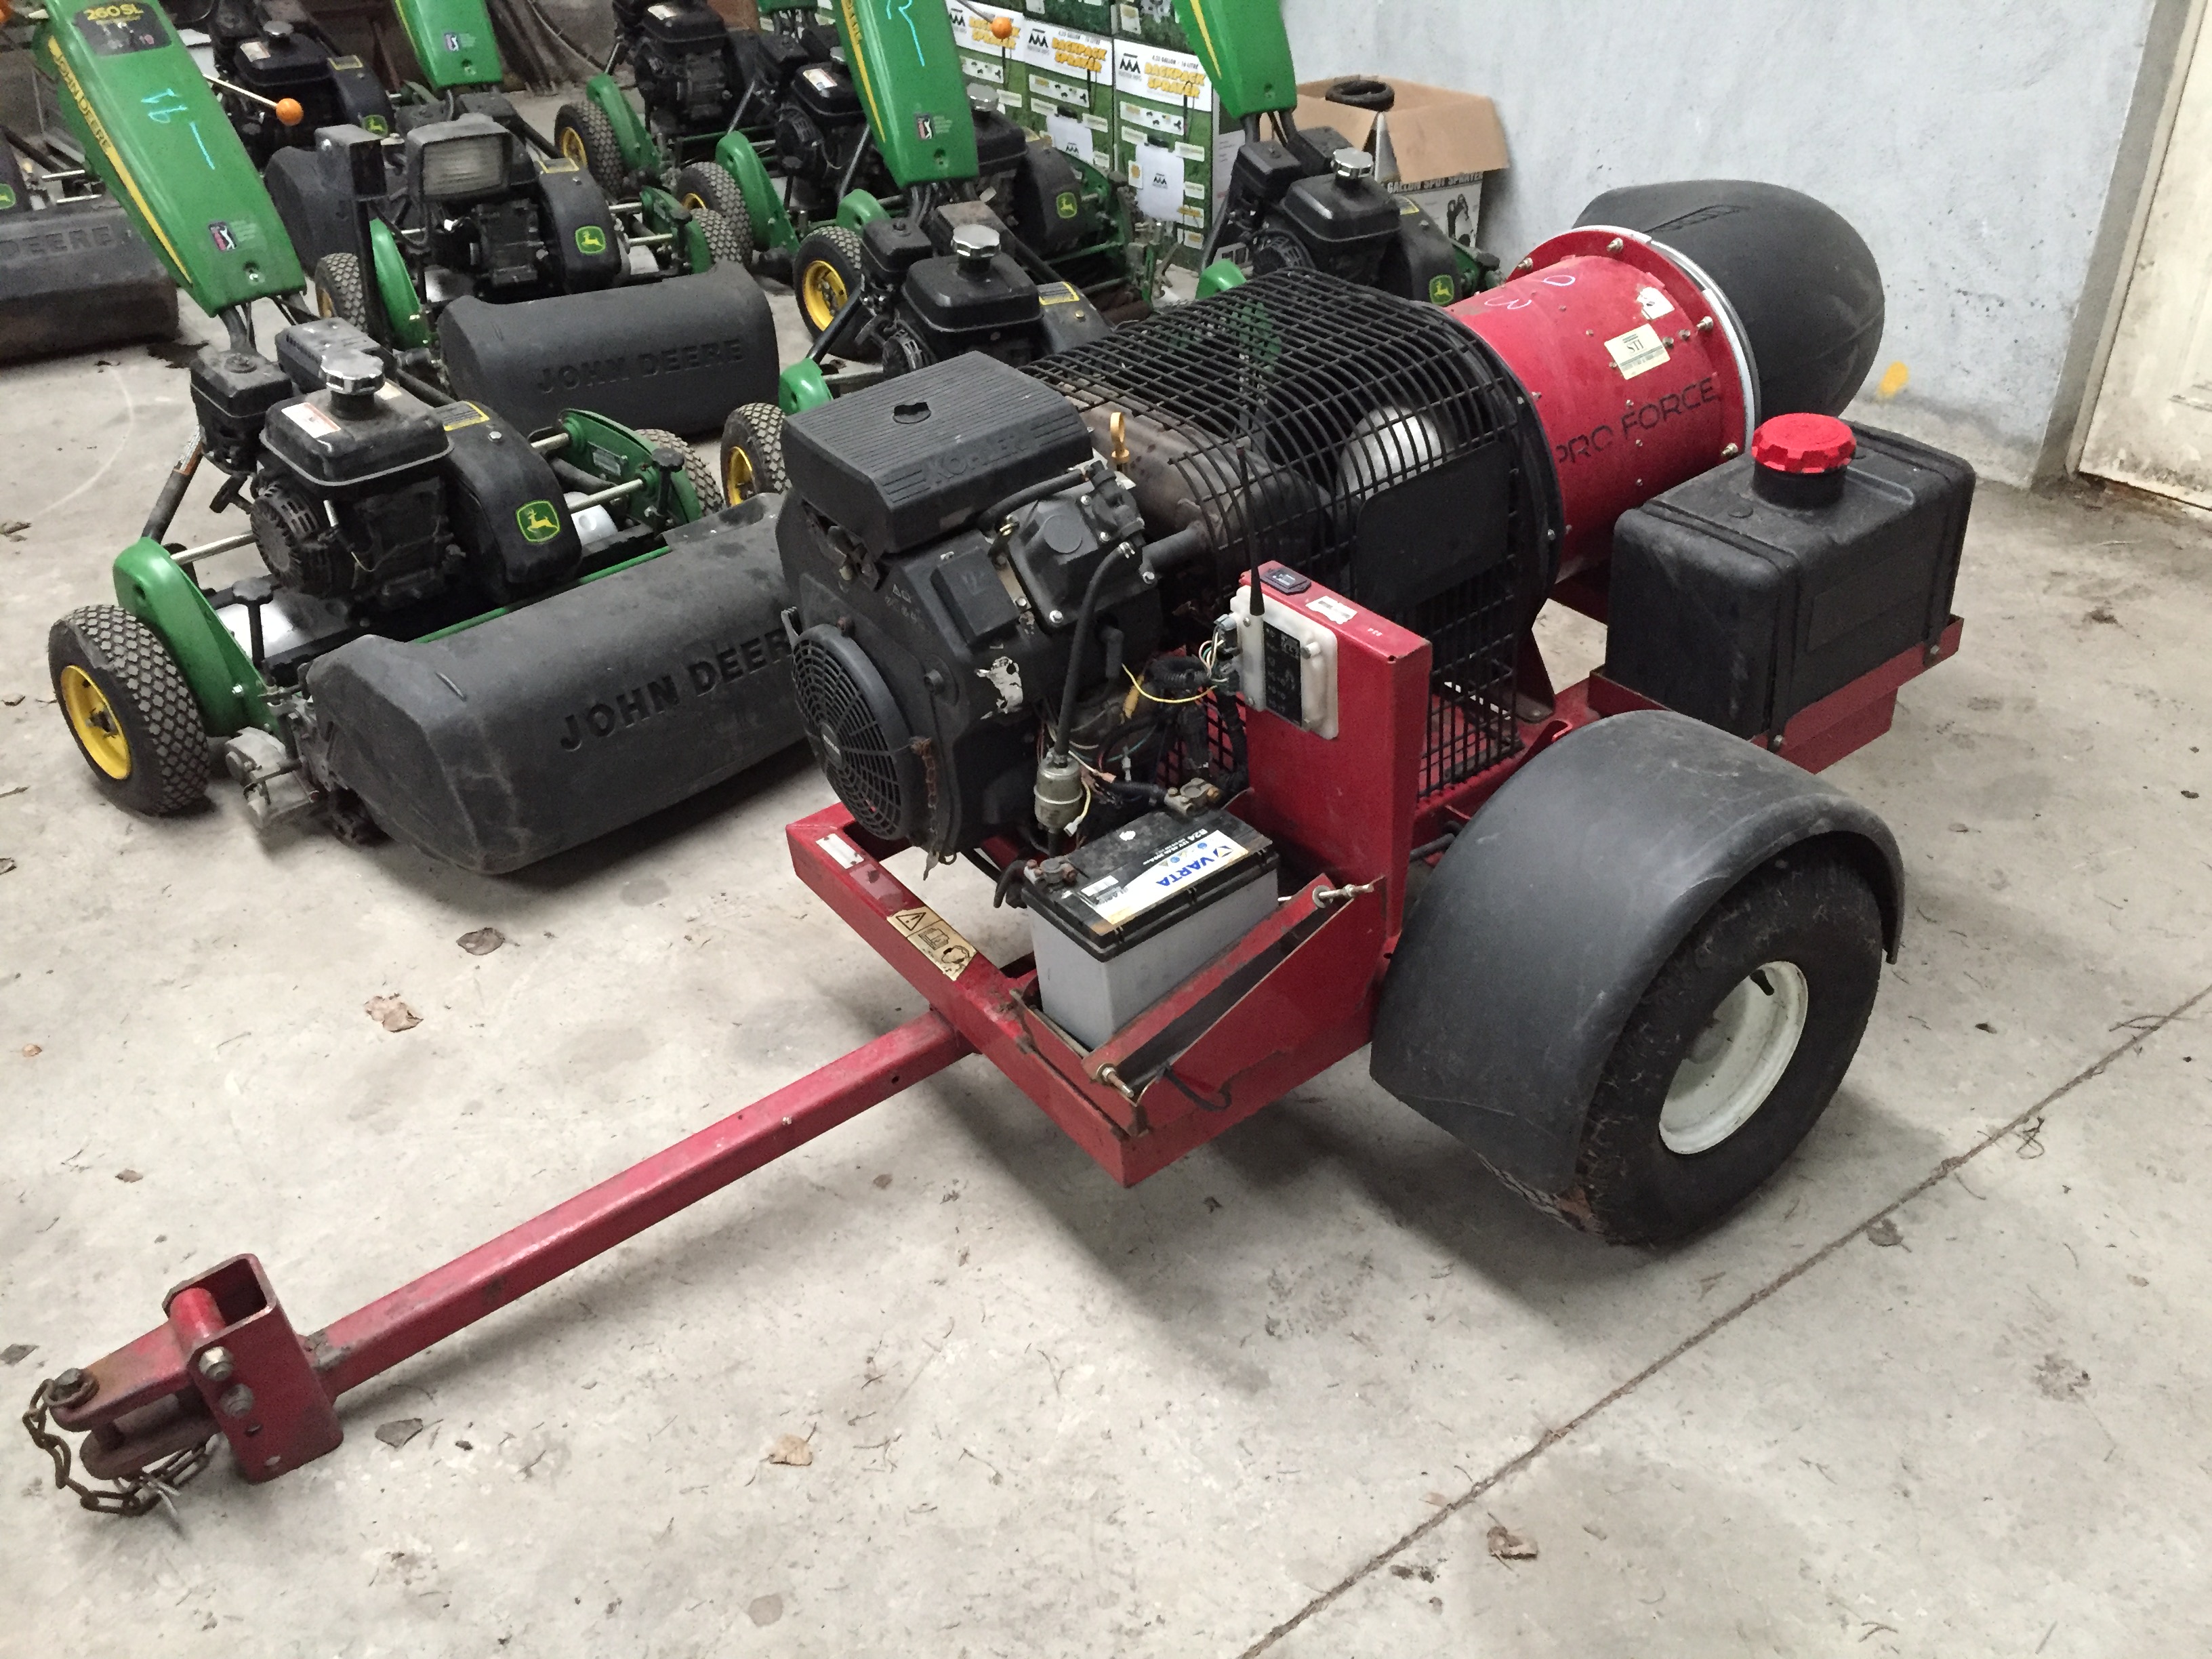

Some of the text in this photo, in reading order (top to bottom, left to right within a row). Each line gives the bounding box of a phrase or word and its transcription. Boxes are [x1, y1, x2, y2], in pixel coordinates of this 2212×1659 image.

[1051, 37, 1108, 62] BACKPACK
[1054, 51, 1103, 74] SPRAYER
[1144, 62, 1205, 86] BACKPACK
[1147, 76, 1200, 98] SPRAYER
[54, 54, 112, 151] JOHN DEERE
[537, 338, 745, 394] JOHN DEERE
[1621, 377, 1721, 441] FORCE
[560, 674, 680, 752] JOHN
[1155, 856, 1215, 887] VARTA
